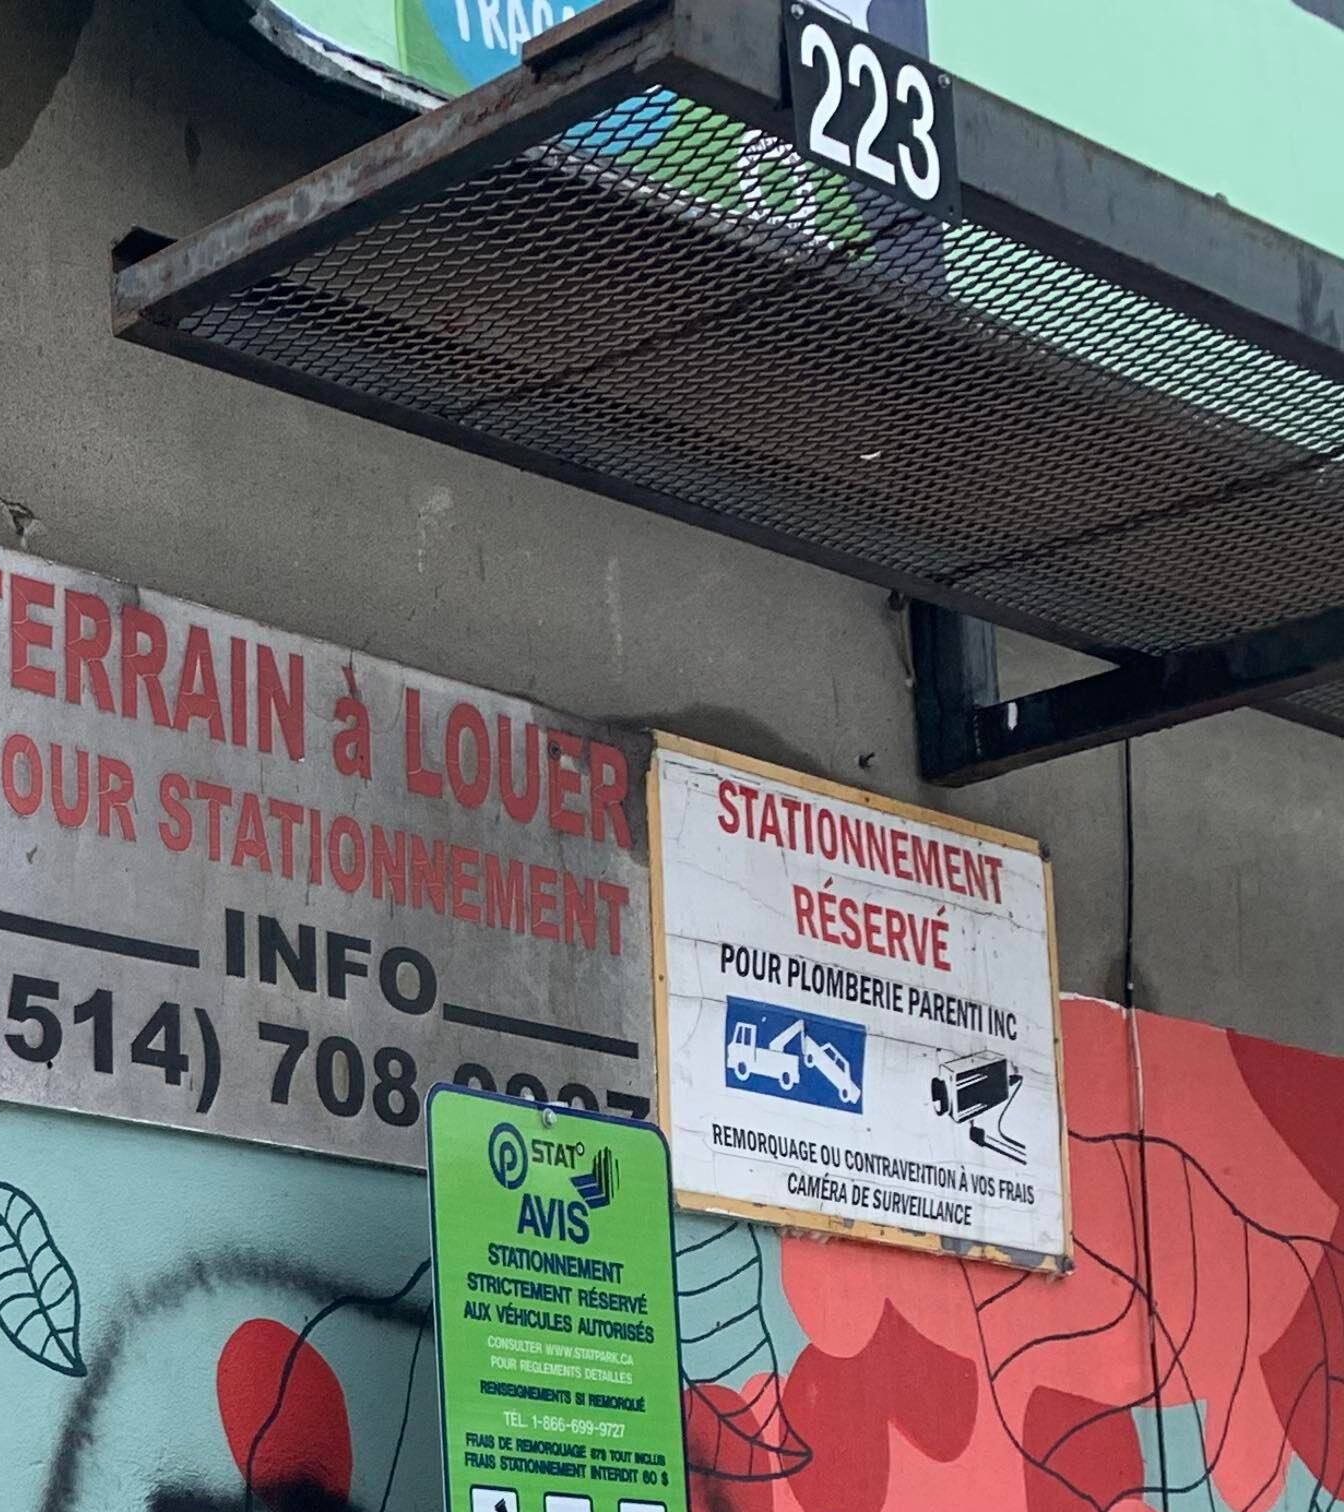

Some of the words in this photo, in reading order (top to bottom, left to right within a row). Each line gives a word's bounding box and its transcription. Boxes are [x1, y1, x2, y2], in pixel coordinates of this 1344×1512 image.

[801, 23, 940, 200] 223
[333, 666, 372, 779] à
[405, 688, 632, 849] LOUER
[158, 772, 629, 956] STATIONNEMENT
[717, 779, 1003, 905] STATIONNEMENT
[793, 877, 951, 972] RÉSERVÉ
[225, 908, 437, 1016] INFO
[721, 942, 793, 986] POUR
[787, 960, 903, 1015] PLOMBERIE
[909, 987, 983, 1034] PARENTI
[989, 1006, 1018, 1041] INC
[258, 1023, 420, 1127] 708
[712, 1123, 817, 1165] REMORQUAGE
[821, 1144, 841, 1167] OU
[845, 1149, 956, 1190] CONTRAVENTION
[959, 1166, 969, 1192] À
[970, 1174, 996, 1198] VOS
[999, 1180, 1035, 1205] FRAIS
[517, 1193, 589, 1244] AVIS
[788, 1172, 847, 1202] CAMÉRA
[852, 1184, 869, 1205] DE
[872, 1187, 973, 1226] SURVEILLANCE
[488, 1242, 624, 1284] STATIONNEMENT
[467, 1272, 572, 1304] STRICTEMENT
[578, 1286, 648, 1315] RÉSERVÉ
[464, 1301, 491, 1322] AUX
[496, 1303, 573, 1333] VÉHICULES
[578, 1317, 654, 1344] AUTORISÉS
[487, 1336, 542, 1353] CONSULTER
[490, 1355, 517, 1371] POUR
[480, 1379, 572, 1405] RENSEIGNEMENTS
[574, 1392, 586, 1406] SI
[465, 1432, 495, 1449] FRAIS
[498, 1436, 513, 1451] DE
[515, 1438, 587, 1459] REMORQUAGE
[531, 1414, 626, 1438] 1-866-699-9727
[464, 1451, 496, 1470] FRAIS
[500, 1455, 587, 1478] STATIONNEMENT
[590, 1465, 639, 1483] INTERDIT
